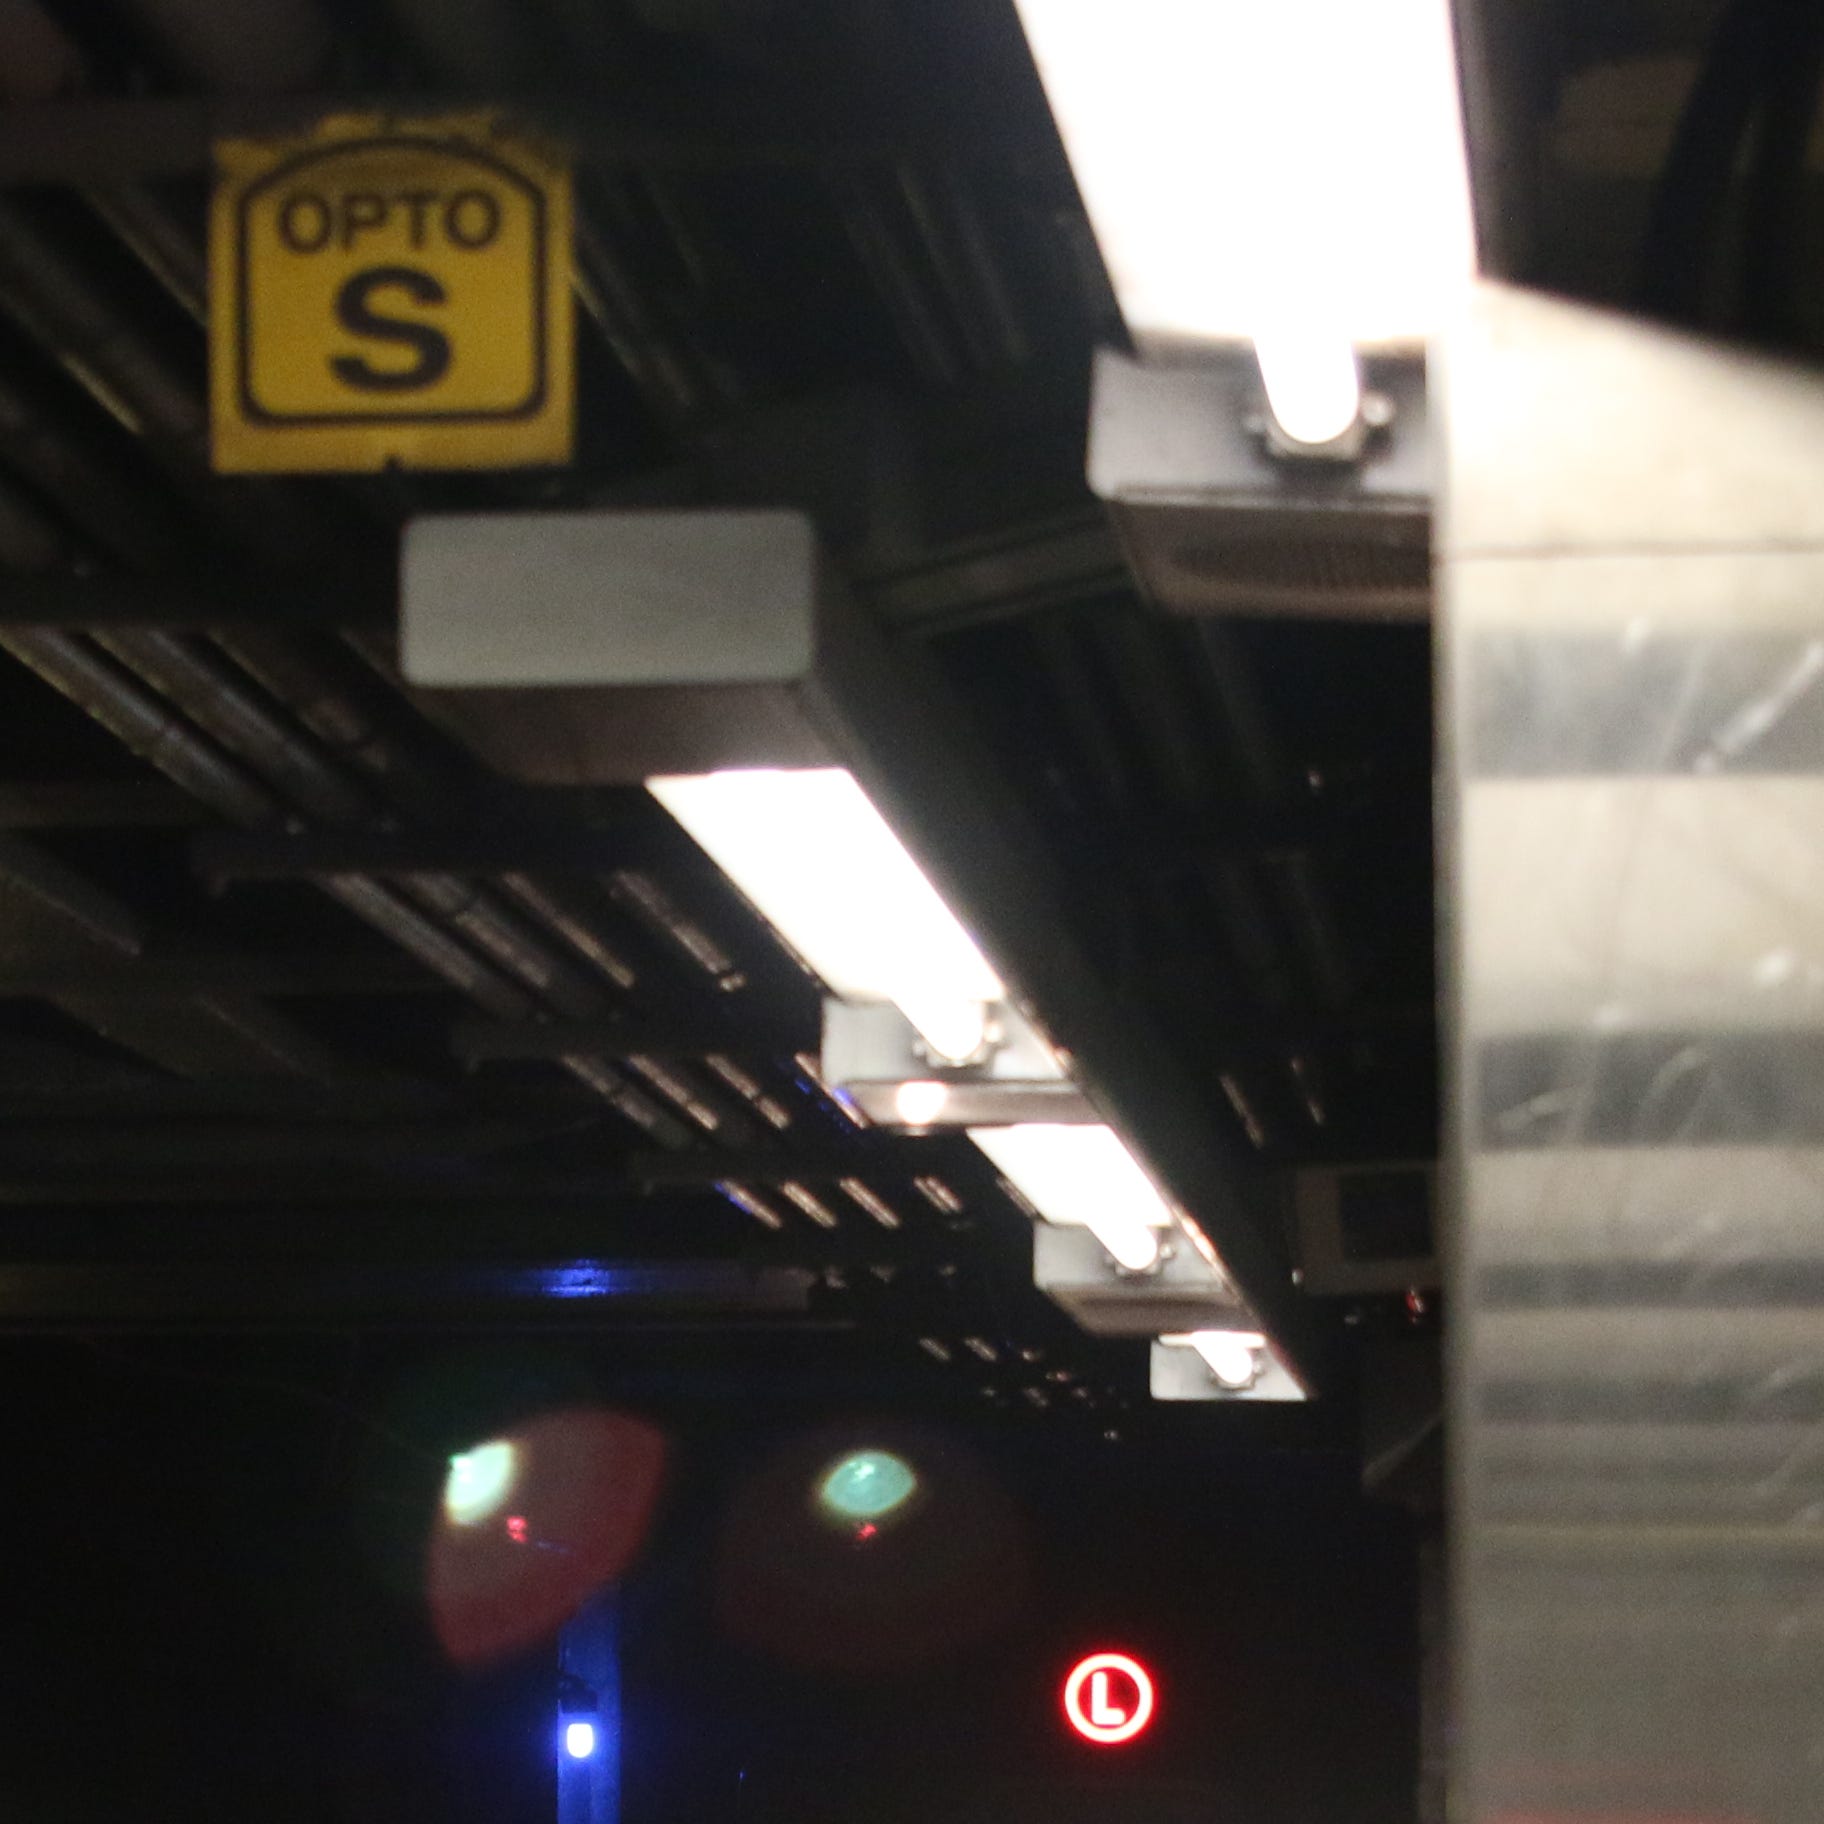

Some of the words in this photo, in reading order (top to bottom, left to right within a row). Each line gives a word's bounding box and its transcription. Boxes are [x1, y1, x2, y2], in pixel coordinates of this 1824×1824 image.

[280, 188, 501, 255] OPTO
[329, 265, 453, 393] S
[1090, 1670, 1126, 1726] L
